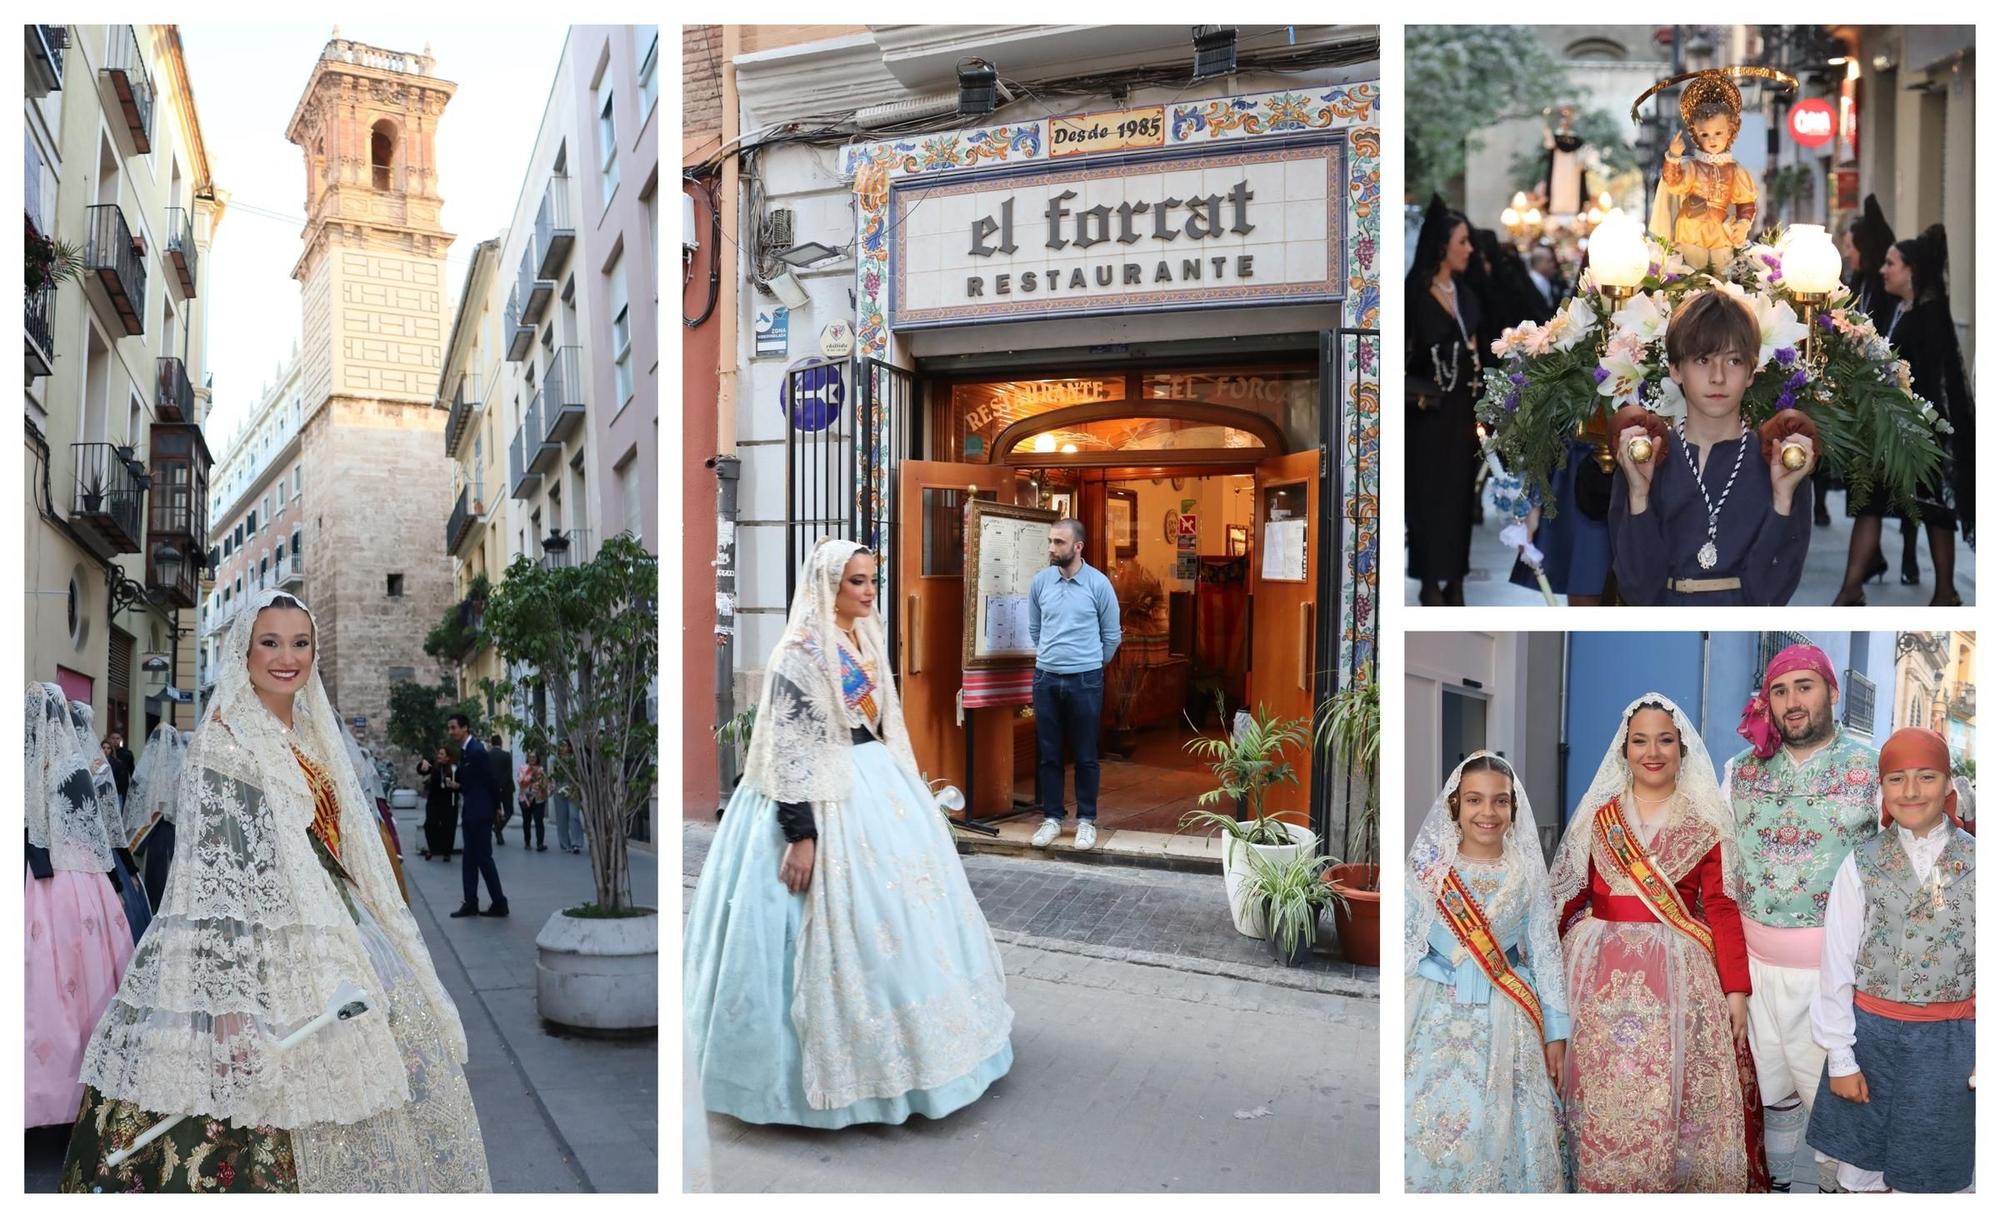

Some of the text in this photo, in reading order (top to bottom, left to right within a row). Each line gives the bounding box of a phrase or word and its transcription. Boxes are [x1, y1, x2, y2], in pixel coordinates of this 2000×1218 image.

[1054, 117, 1161, 144] Desde 1985
[968, 179, 1256, 257] el forcat
[967, 255, 1254, 297] RESTAURANTE
[965, 375, 1298, 432] RESTAURANTE EL FORC
